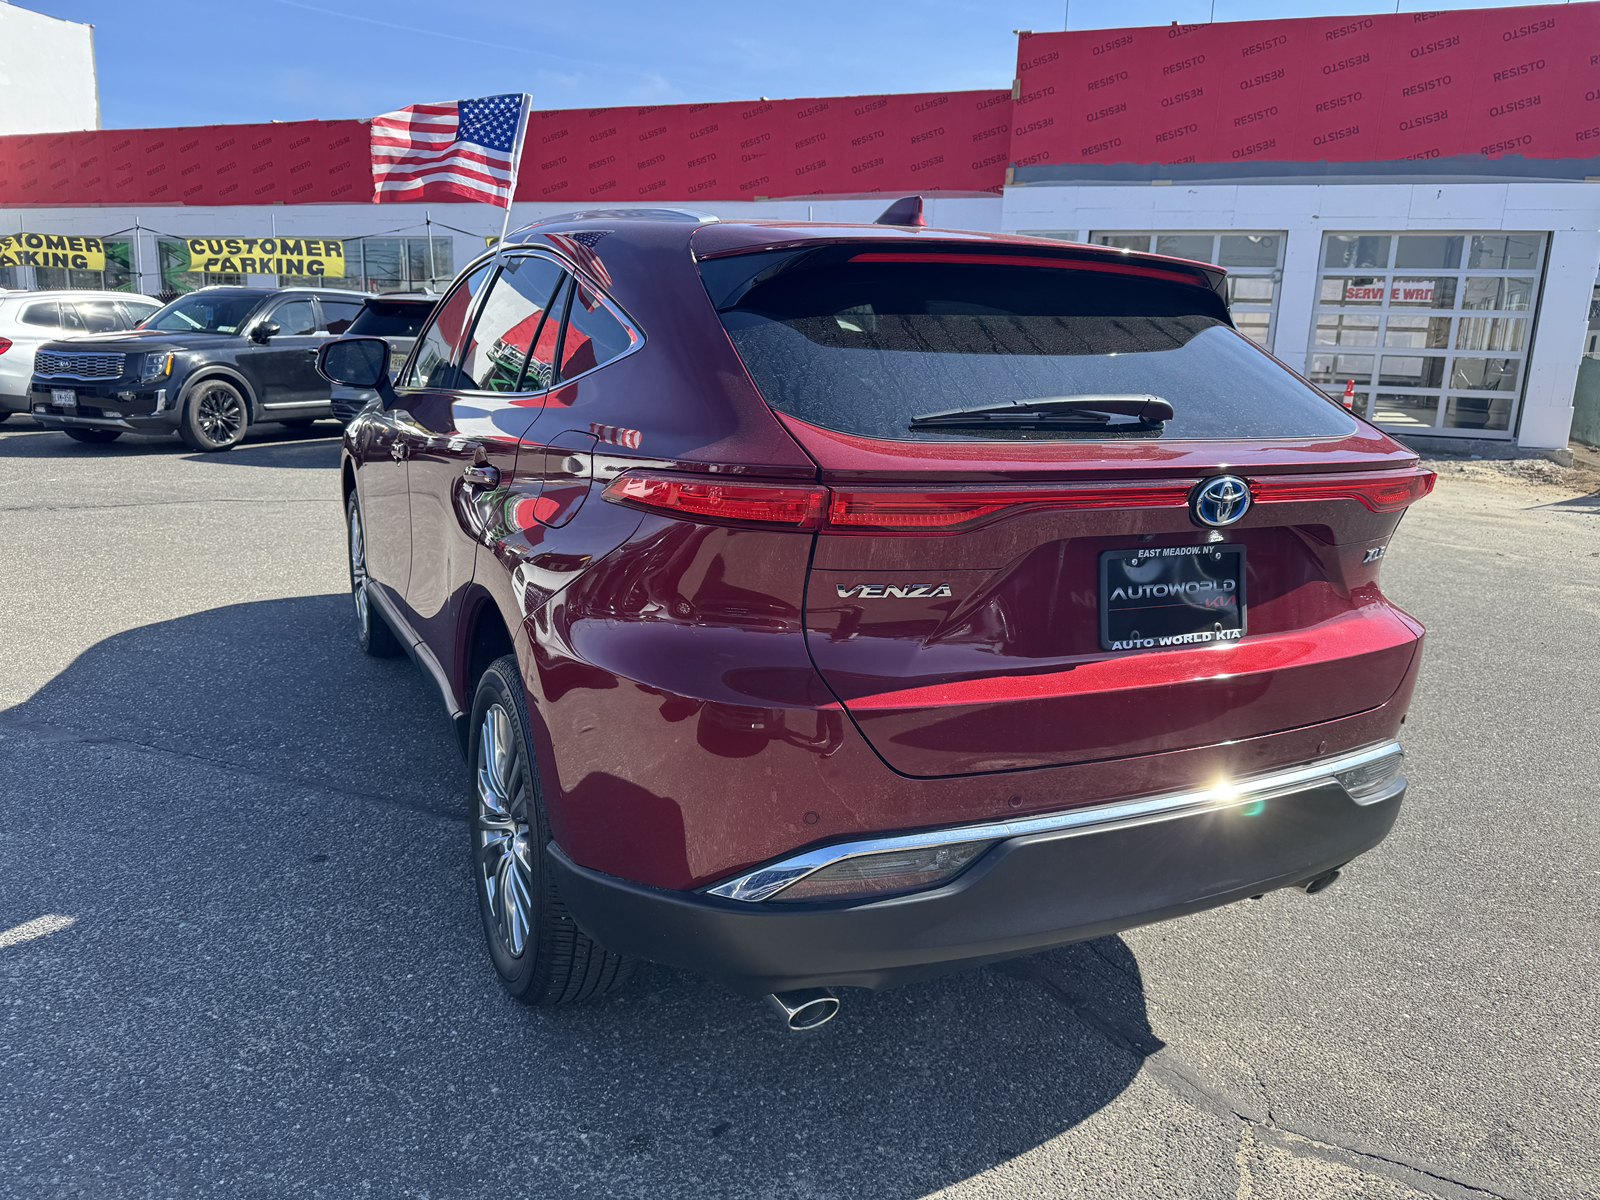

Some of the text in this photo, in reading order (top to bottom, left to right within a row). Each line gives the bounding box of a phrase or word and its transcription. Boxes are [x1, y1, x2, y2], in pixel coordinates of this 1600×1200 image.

[1169, 24, 1211, 38] SISTO
[1325, 19, 1373, 41] RESISTO
[1502, 18, 1556, 42] RESISTO
[1093, 35, 1134, 56] RESISTO
[1241, 35, 1288, 57] RESISTO
[1410, 35, 1460, 58] RESISTO
[1021, 51, 1059, 71] RESISTO
[1163, 55, 1206, 76] RESISTO
[1322, 53, 1370, 75] RESISTO
[1493, 59, 1546, 82] RESISTO
[1088, 71, 1129, 92] RESISTO
[1240, 68, 1285, 90] RESISTO
[1402, 75, 1452, 97] RESISTO
[914, 96, 948, 114] RESISTO
[976, 93, 1011, 111] RESISTO
[1161, 87, 1204, 108] RESISTO
[1315, 92, 1363, 113] RESISTO
[1489, 95, 1541, 117] RESISTO
[797, 102, 829, 119] RESISTO
[854, 99, 887, 117] RESISTO
[1087, 102, 1127, 123] RESISTO
[1234, 106, 1279, 127] RESISTO
[1015, 117, 1054, 136] RESISTO
[1399, 110, 1448, 131] RESISTO
[795, 132, 826, 149] RESISTO
[852, 130, 884, 147] RESISTO
[911, 127, 945, 144] RESISTO
[973, 125, 1008, 143] RESISTO
[1155, 123, 1198, 143] RESISTO
[1313, 125, 1360, 145] RESISTO
[1081, 138, 1122, 157] RESISTO
[1231, 138, 1276, 159] RESISTO
[795, 159, 826, 175] RESISTO
[852, 157, 884, 174] RESISTO
[911, 155, 944, 172] RESISTO
[972, 152, 1007, 171] RESISTO
[0, 233, 102, 253] STOMER
[189, 239, 342, 257] CUSTOMER
[204, 257, 325, 276] PARKING
[1346, 288, 1400, 299] SERVIE
[1138, 549, 1161, 558] EAST
[1202, 546, 1215, 554] NY
[836, 582, 952, 598] VENZA
[1110, 579, 1236, 601] AUTOWORLD
[1206, 596, 1236, 608] KIA
[1112, 629, 1242, 650] AUTO WORLD KIA
